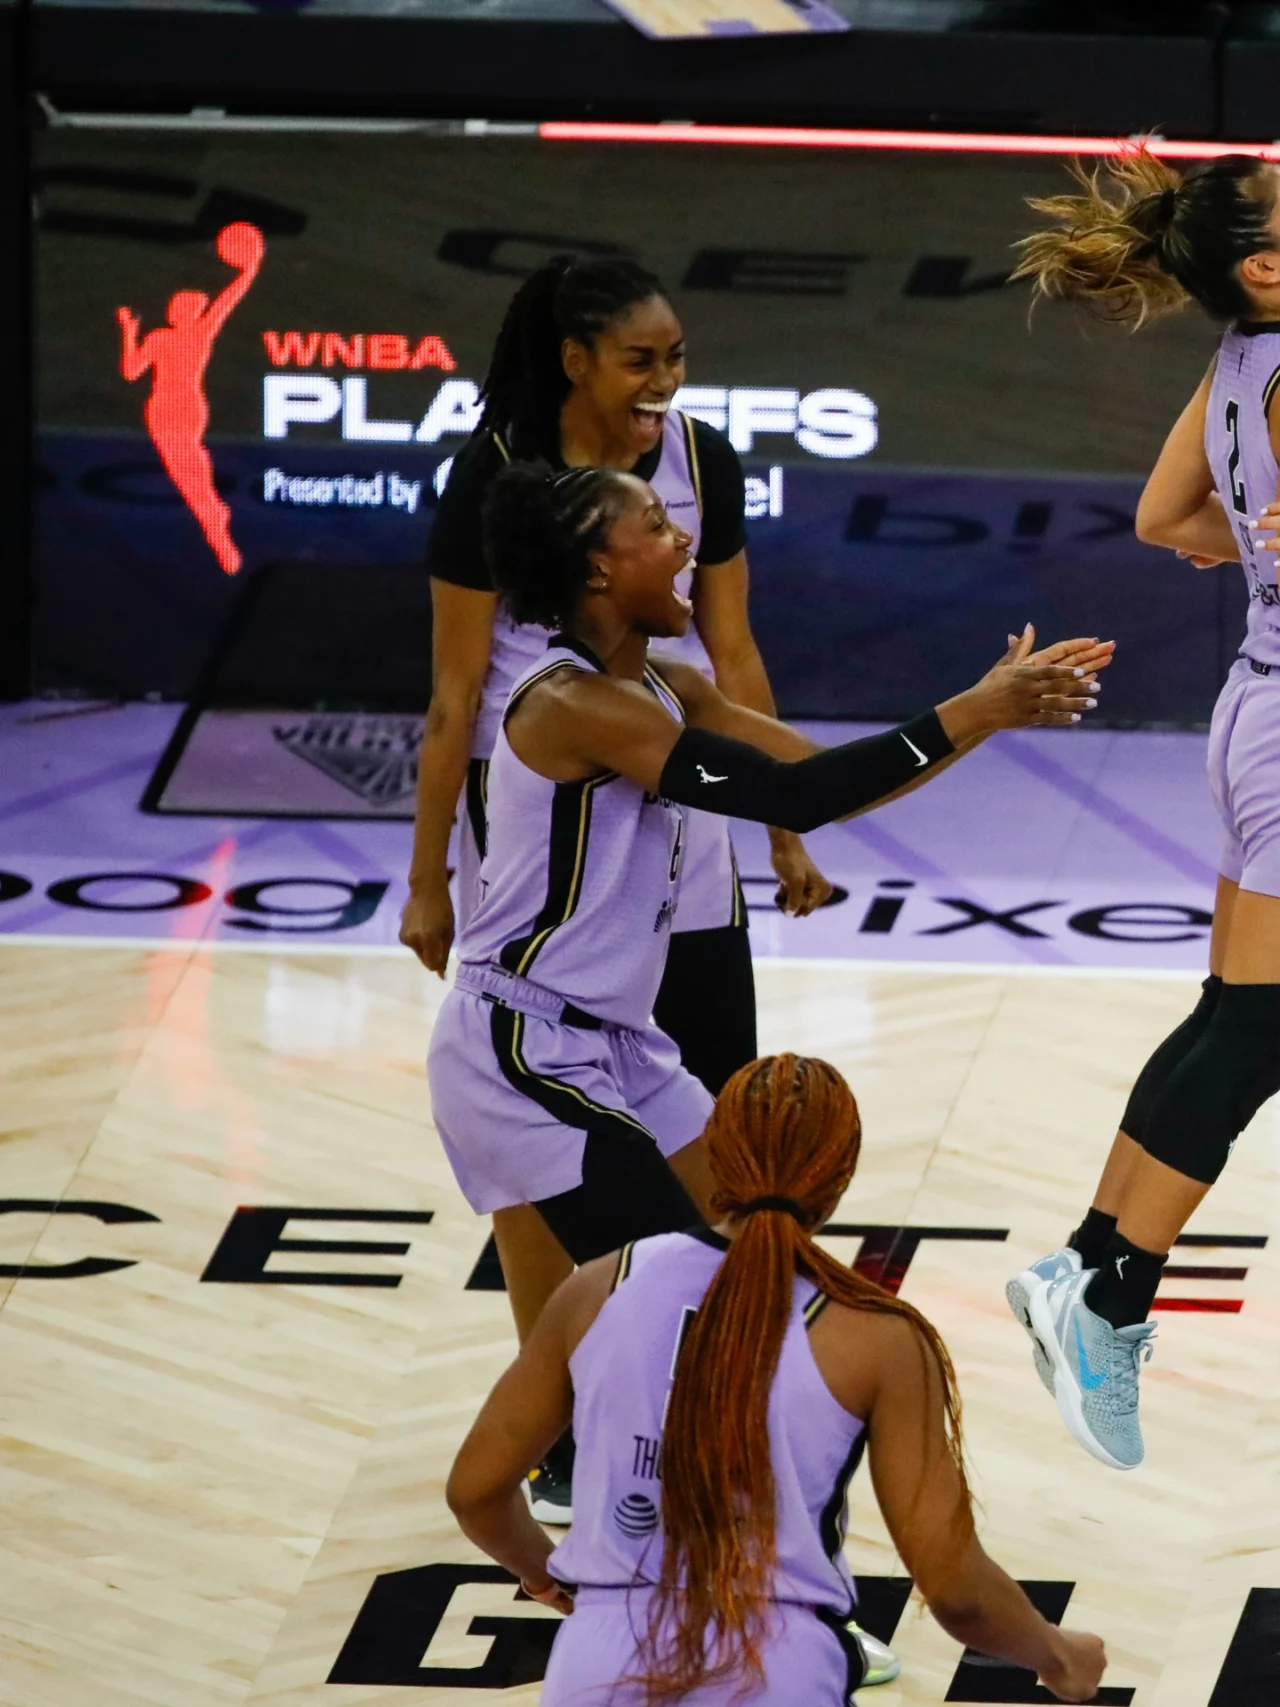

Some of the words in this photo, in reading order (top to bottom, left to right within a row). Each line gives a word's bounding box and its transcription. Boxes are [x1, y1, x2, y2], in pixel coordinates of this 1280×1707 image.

[263, 331, 457, 371] WNBA
[263, 374, 878, 459] PLAFFS
[1225, 398, 1248, 516] 2
[264, 467, 385, 507] Presented
[388, 471, 422, 514] by
